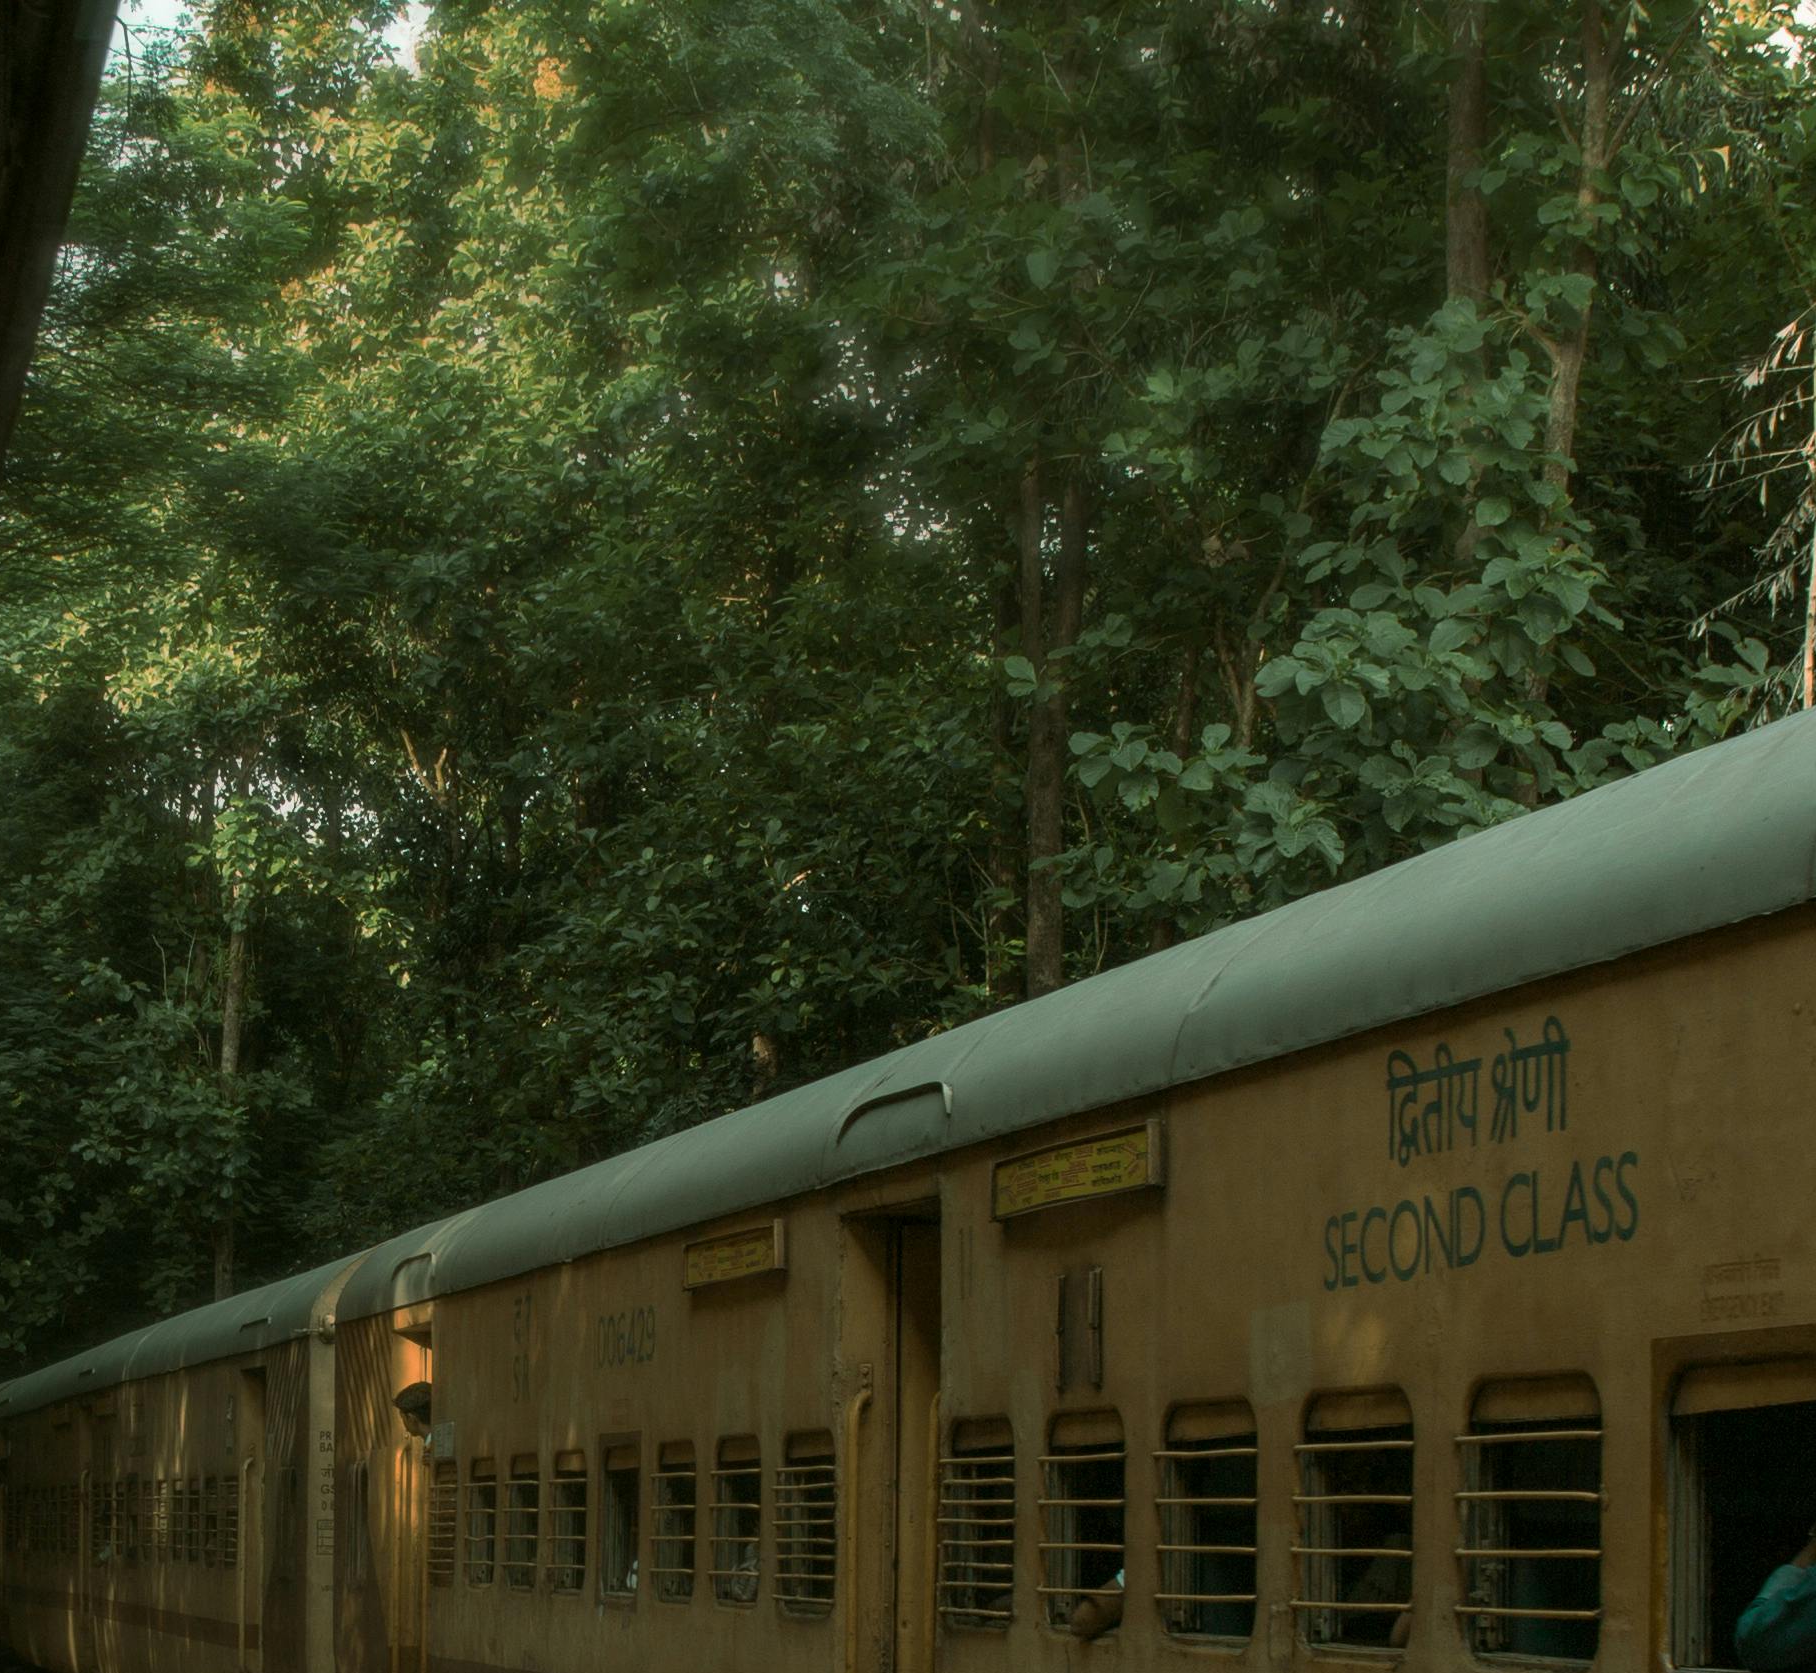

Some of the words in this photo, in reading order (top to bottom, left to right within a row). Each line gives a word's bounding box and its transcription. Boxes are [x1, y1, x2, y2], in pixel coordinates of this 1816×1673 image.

[1387, 1042, 1484, 1168] द्वितीय
[1490, 1015, 1572, 1145] श्रेणी
[1323, 1186, 1485, 1291] SECOND
[1500, 1150, 1639, 1258] CLASS
